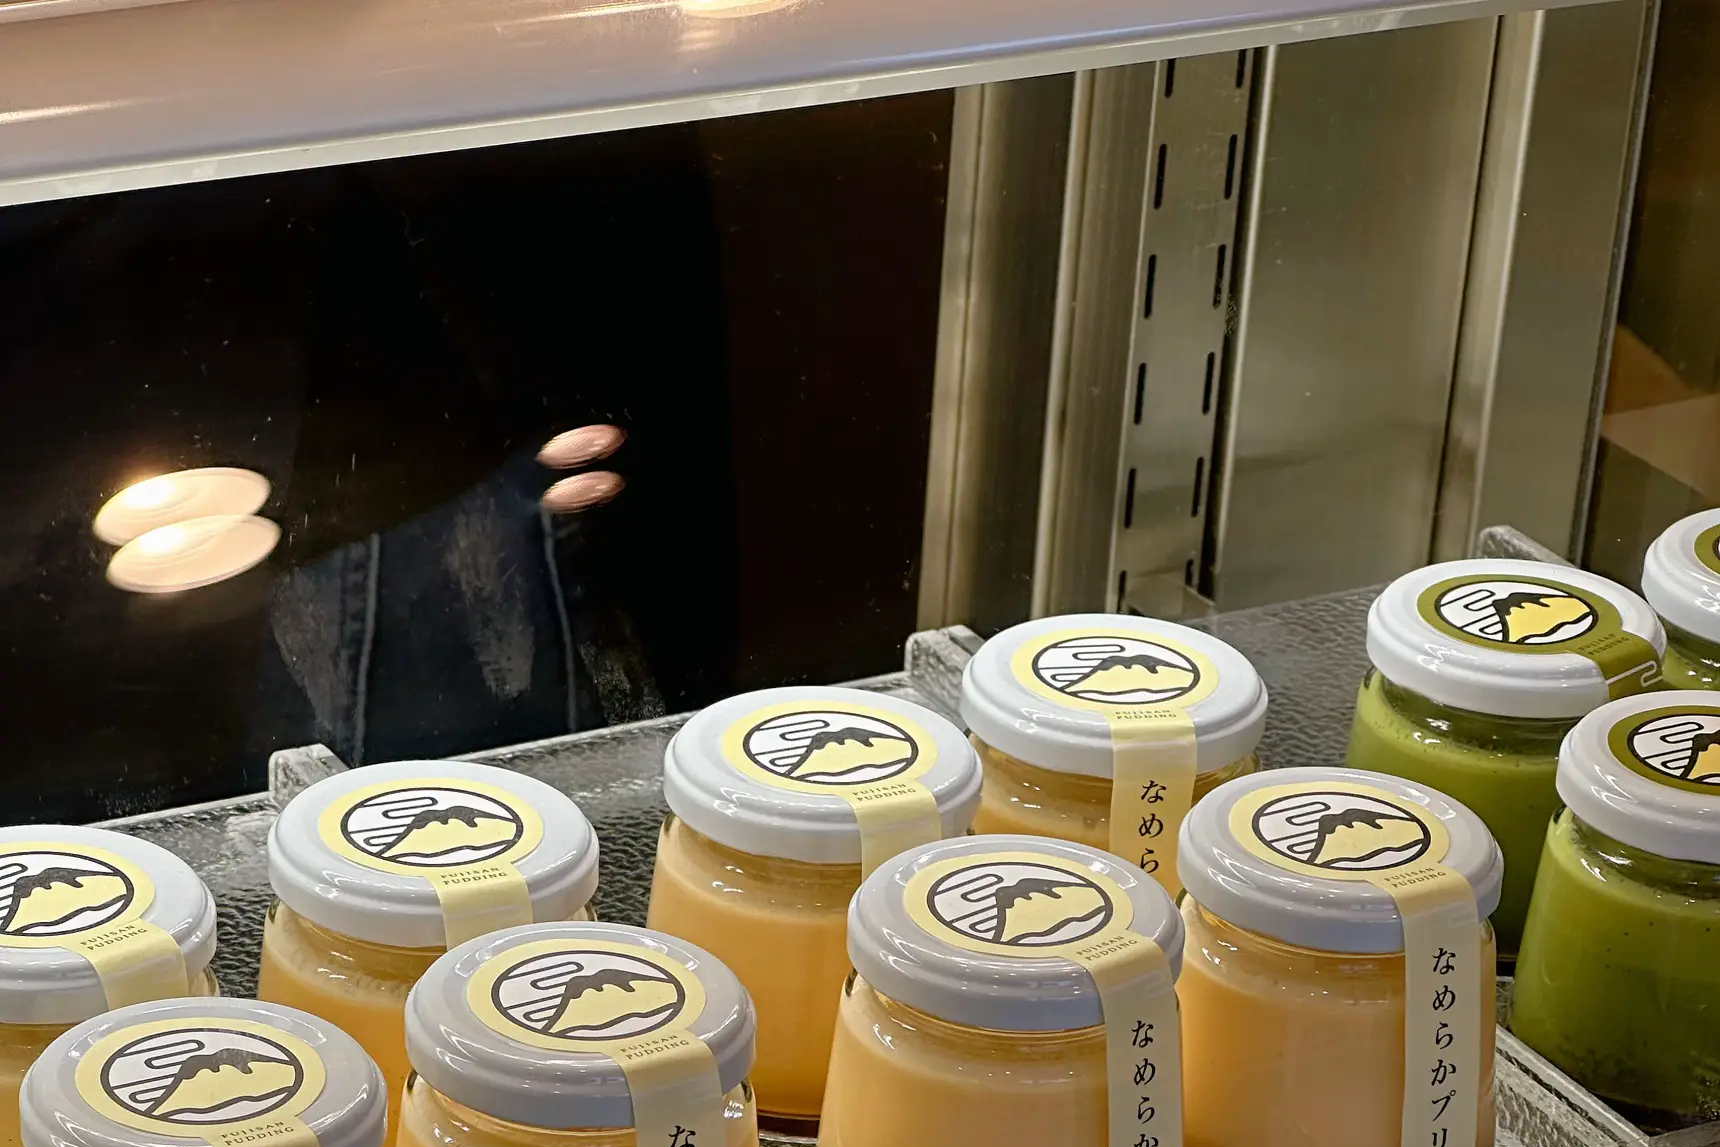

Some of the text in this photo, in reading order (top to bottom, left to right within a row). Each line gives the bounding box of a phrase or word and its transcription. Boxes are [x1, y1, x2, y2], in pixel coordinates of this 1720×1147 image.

[856, 788, 916, 801] PUDDING
[1138, 780, 1167, 873] なめら
[443, 872, 508, 885] PUDDING
[1384, 867, 1435, 882] FUJISAN
[1391, 871, 1447, 888] PUDDING
[80, 925, 136, 945] FUJISAN
[87, 928, 147, 950] PUDDING
[1076, 935, 1125, 955] FUJISAN
[1084, 939, 1138, 961] PUDDING
[619, 1034, 679, 1053] FUJISAN
[625, 1040, 690, 1059] PUDDING
[221, 1121, 285, 1139] FUJISAN
[225, 1126, 295, 1146] PUDDING
